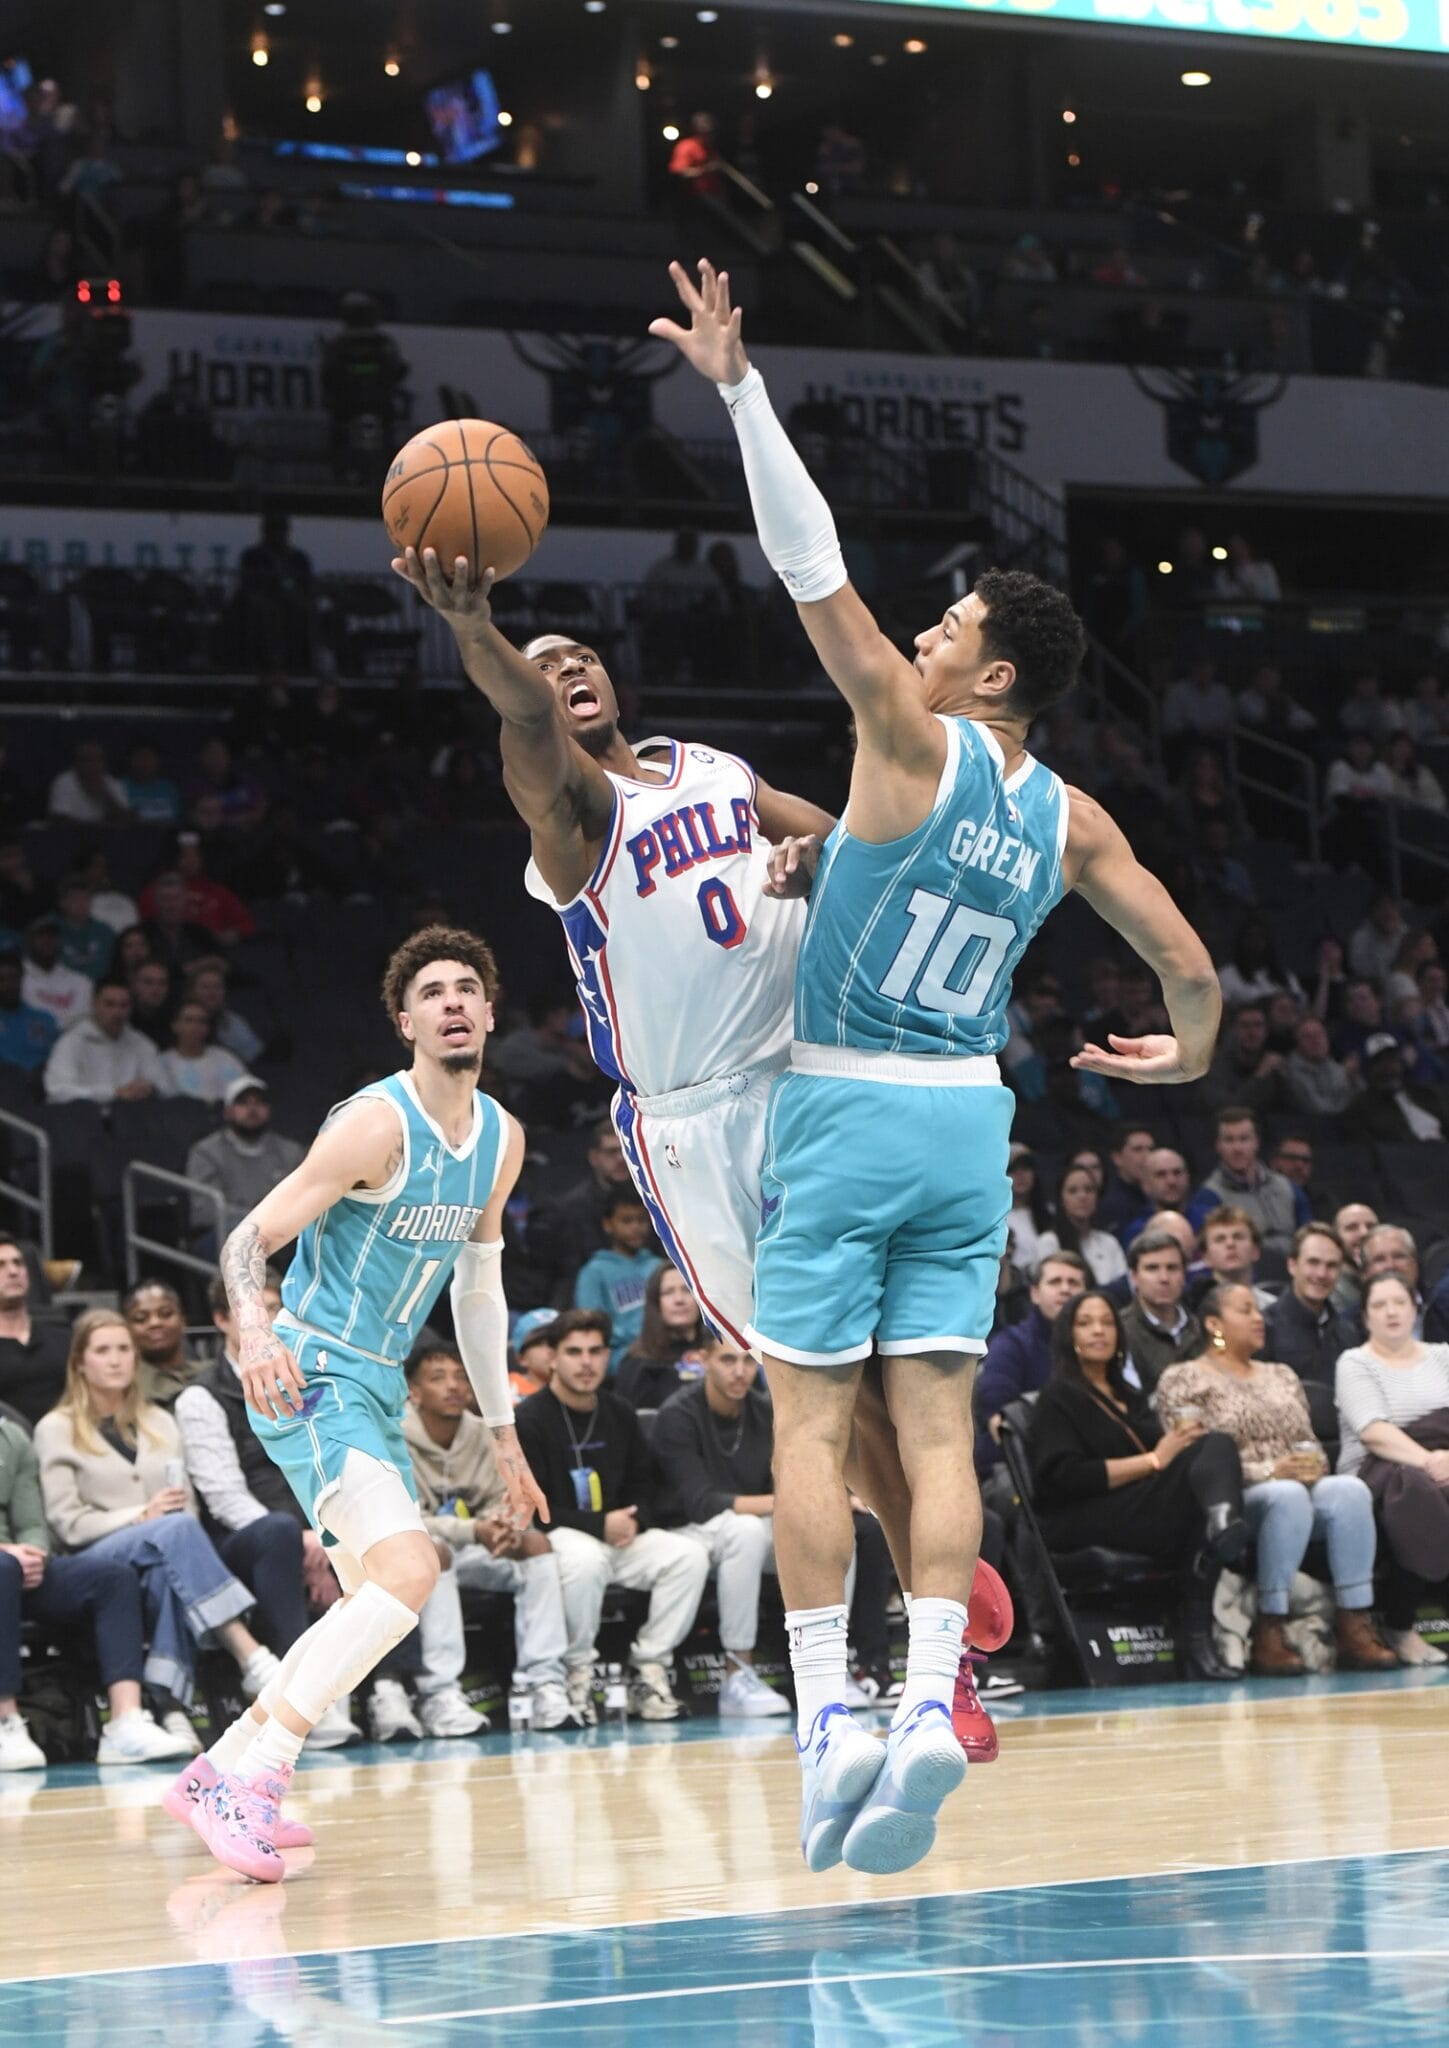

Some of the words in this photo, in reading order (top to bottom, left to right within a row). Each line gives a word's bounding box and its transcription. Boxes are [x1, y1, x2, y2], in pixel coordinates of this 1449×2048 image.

[697, 876, 748, 950] 0
[876, 886, 1019, 1018] 10
[395, 1258, 443, 1326] 1
